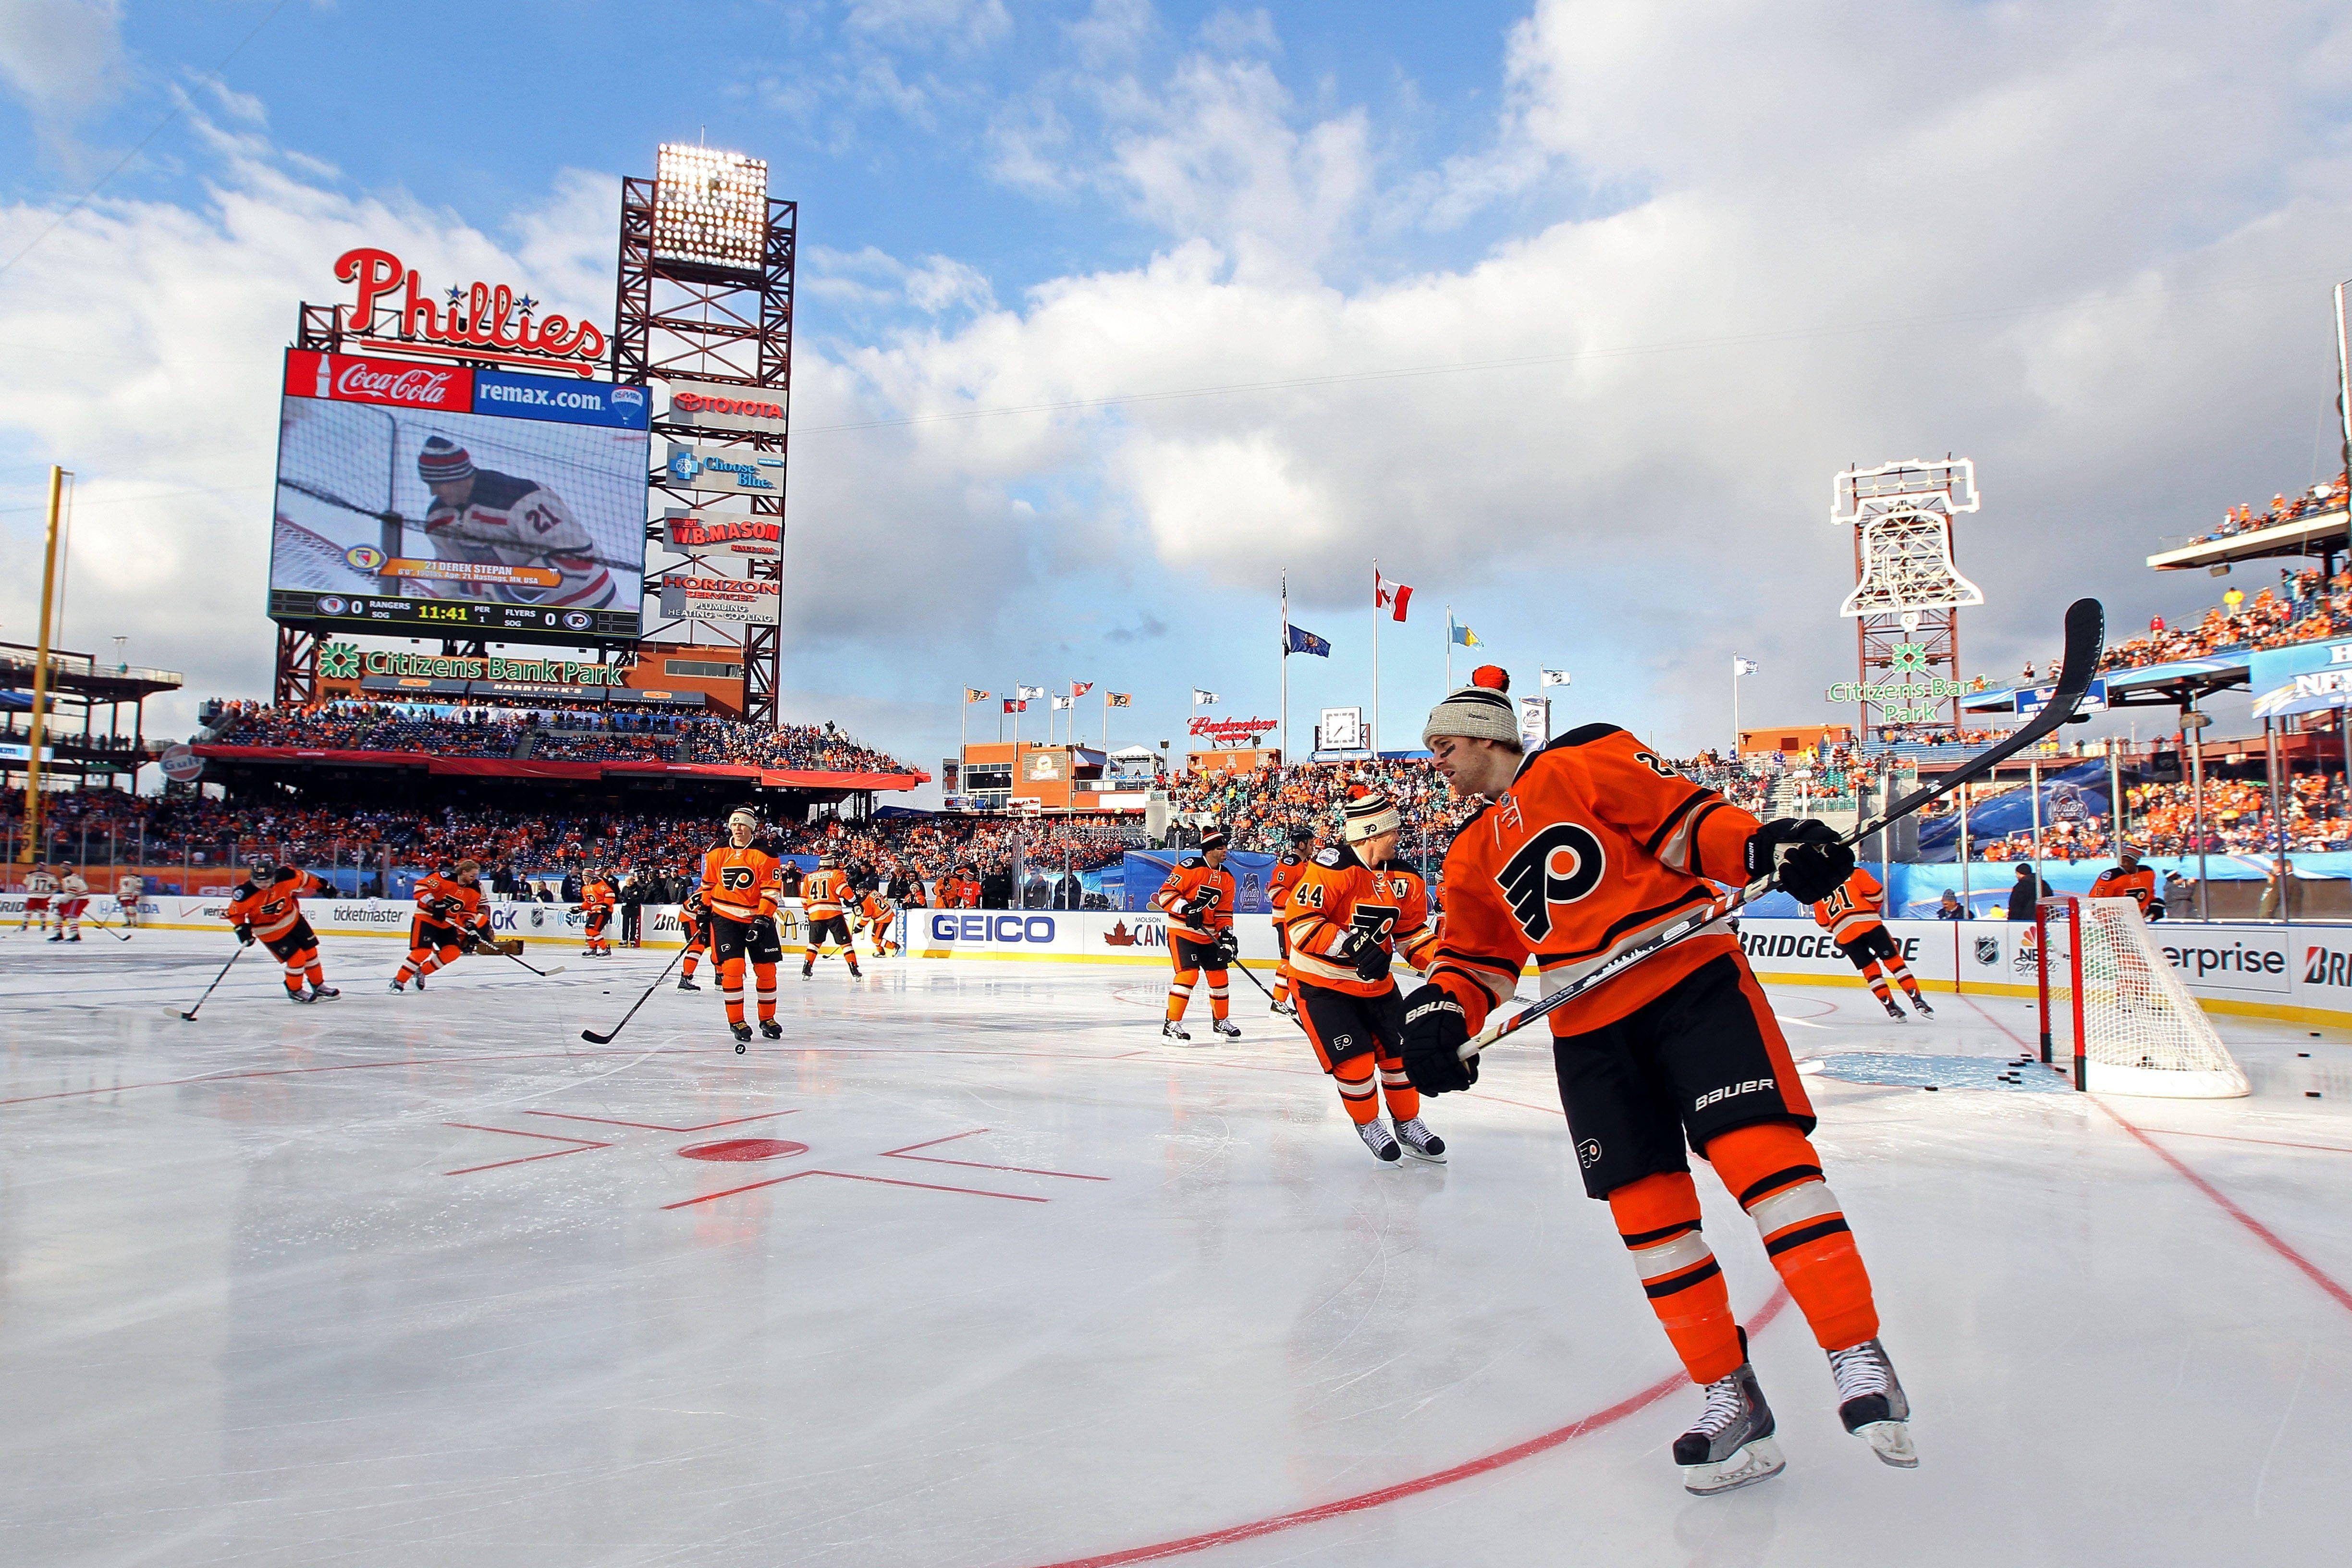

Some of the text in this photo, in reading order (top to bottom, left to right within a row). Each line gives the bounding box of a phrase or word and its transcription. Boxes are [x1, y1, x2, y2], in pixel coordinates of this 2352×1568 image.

[334, 247, 607, 359] Phillies
[337, 363, 453, 404] Coca-Cola
[480, 383, 601, 411] remax.com
[702, 396, 783, 419] TOYOTA
[703, 456, 756, 474] Choose
[738, 473, 773, 489] Blue.
[526, 504, 563, 535] 21
[731, 544, 756, 552] SINCE
[425, 561, 513, 576] 21 DEREK STEPAN
[663, 576, 779, 595] HORIZON
[685, 590, 755, 601] SERVICES
[351, 600, 411, 614] 0 RANGERS
[371, 611, 390, 619] SOG
[418, 605, 468, 621] 11:41
[474, 605, 490, 613] PER
[505, 608, 536, 618] FLYERS
[695, 602, 746, 612] PLUMBING
[504, 619, 522, 627] SOG
[544, 612, 556, 626] 0
[668, 609, 772, 622] HEATING COOLING
[366, 649, 625, 686] Citizens Bank Park
[493, 683, 541, 692] HARRY
[1829, 681, 1926, 702] Citizens
[1883, 701, 1938, 724] Park
[1187, 715, 1278, 736] Budweiser
[1226, 754, 1236, 764] 14
[772, 868, 782, 881] 6
[1164, 872, 1183, 888] 27
[1276, 870, 1286, 882] 6
[810, 879, 830, 901] 41
[1295, 882, 1324, 909] 44
[1396, 881, 1405, 896] A
[1823, 883, 1856, 919] 21
[333, 905, 403, 922] ticketmaster
[931, 915, 1055, 943] GEICO
[1134, 924, 1166, 947] CAN
[1405, 1001, 1466, 1025] BAUER
[1694, 1078, 1775, 1112] BAUER
